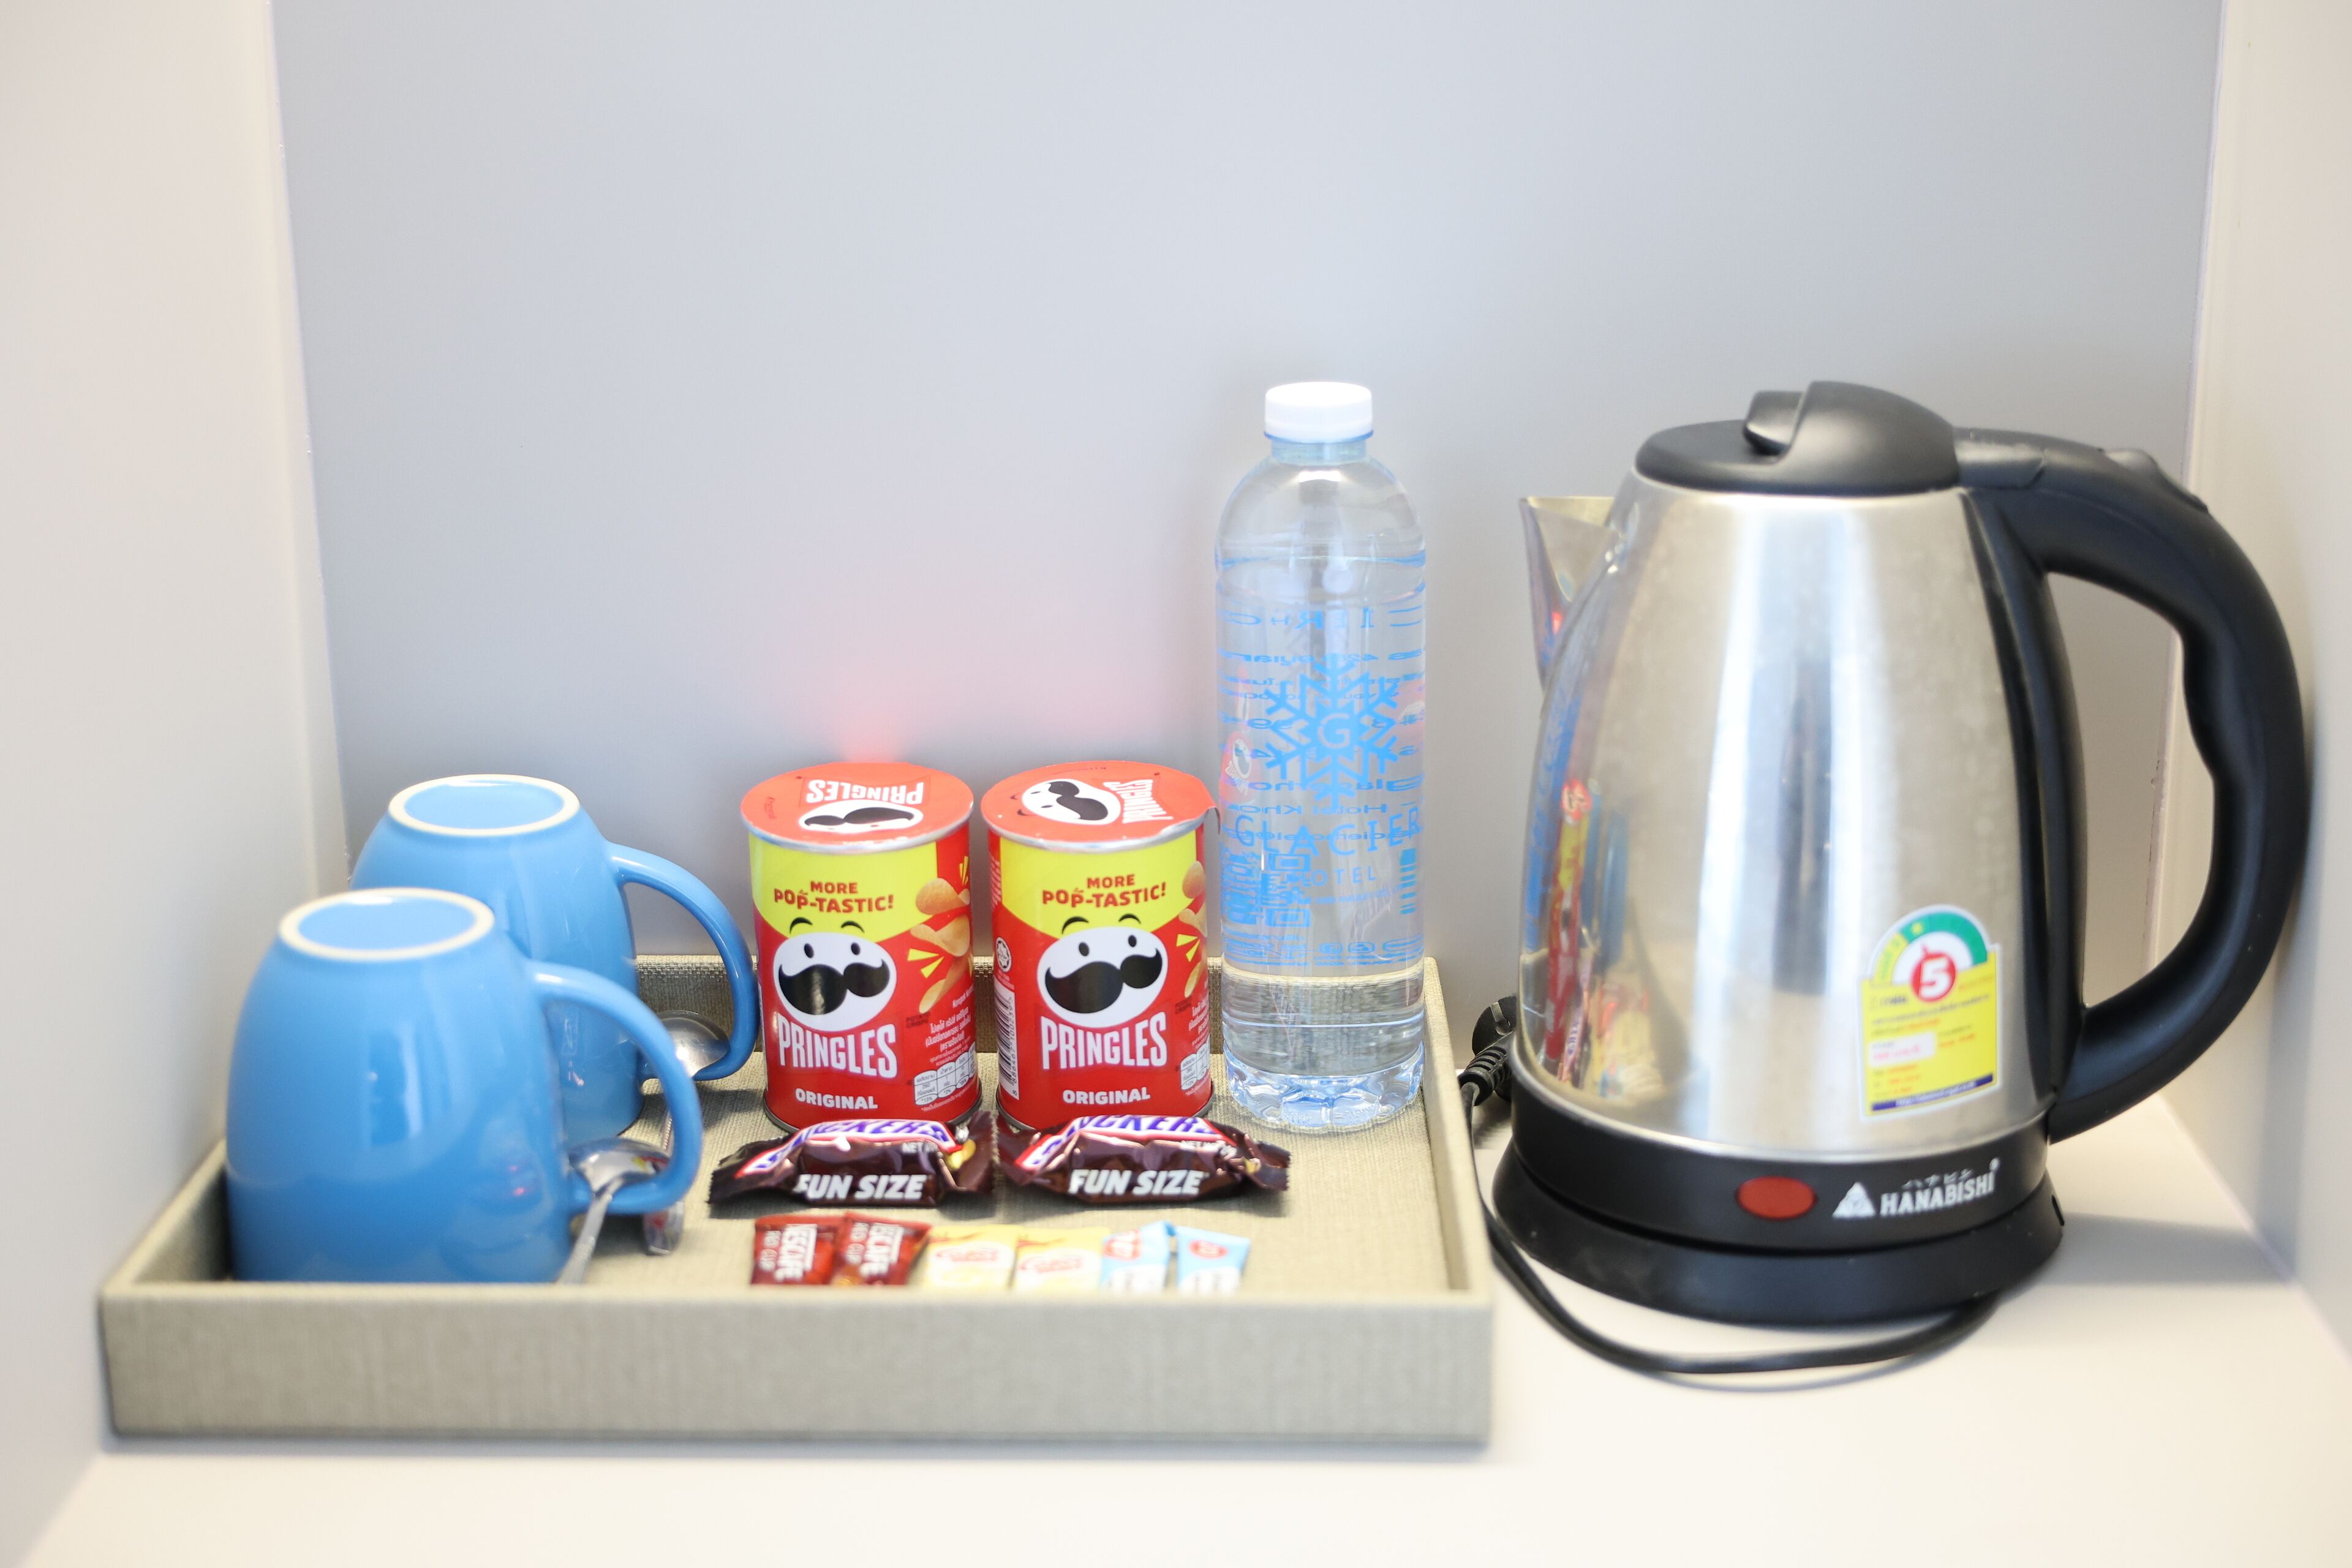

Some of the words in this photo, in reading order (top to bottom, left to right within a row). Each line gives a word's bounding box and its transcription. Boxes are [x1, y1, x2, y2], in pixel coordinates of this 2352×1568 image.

[806, 779, 924, 805] PRINGLES
[1102, 779, 1174, 824] PRINGLES
[1235, 806, 1422, 856] GLACIER
[810, 881, 858, 895] MORE
[1087, 874, 1136, 889] MORE
[774, 888, 894, 913] POP-TASTIC!
[1042, 882, 1167, 908] POP-TASTIC!
[1918, 956, 1953, 999] 5
[777, 1012, 898, 1079] PRINGLES
[1041, 1011, 1168, 1070] PRINGLES
[795, 1088, 878, 1109] ORIGINAL
[1062, 1087, 1151, 1104] ORIGINAL
[793, 1174, 853, 1199] FUN
[854, 1174, 927, 1200] SIZE
[1069, 1169, 1132, 1195] FUN
[1132, 1169, 1202, 1196] SIZE
[1879, 1158, 2000, 1216] HANABISHI
